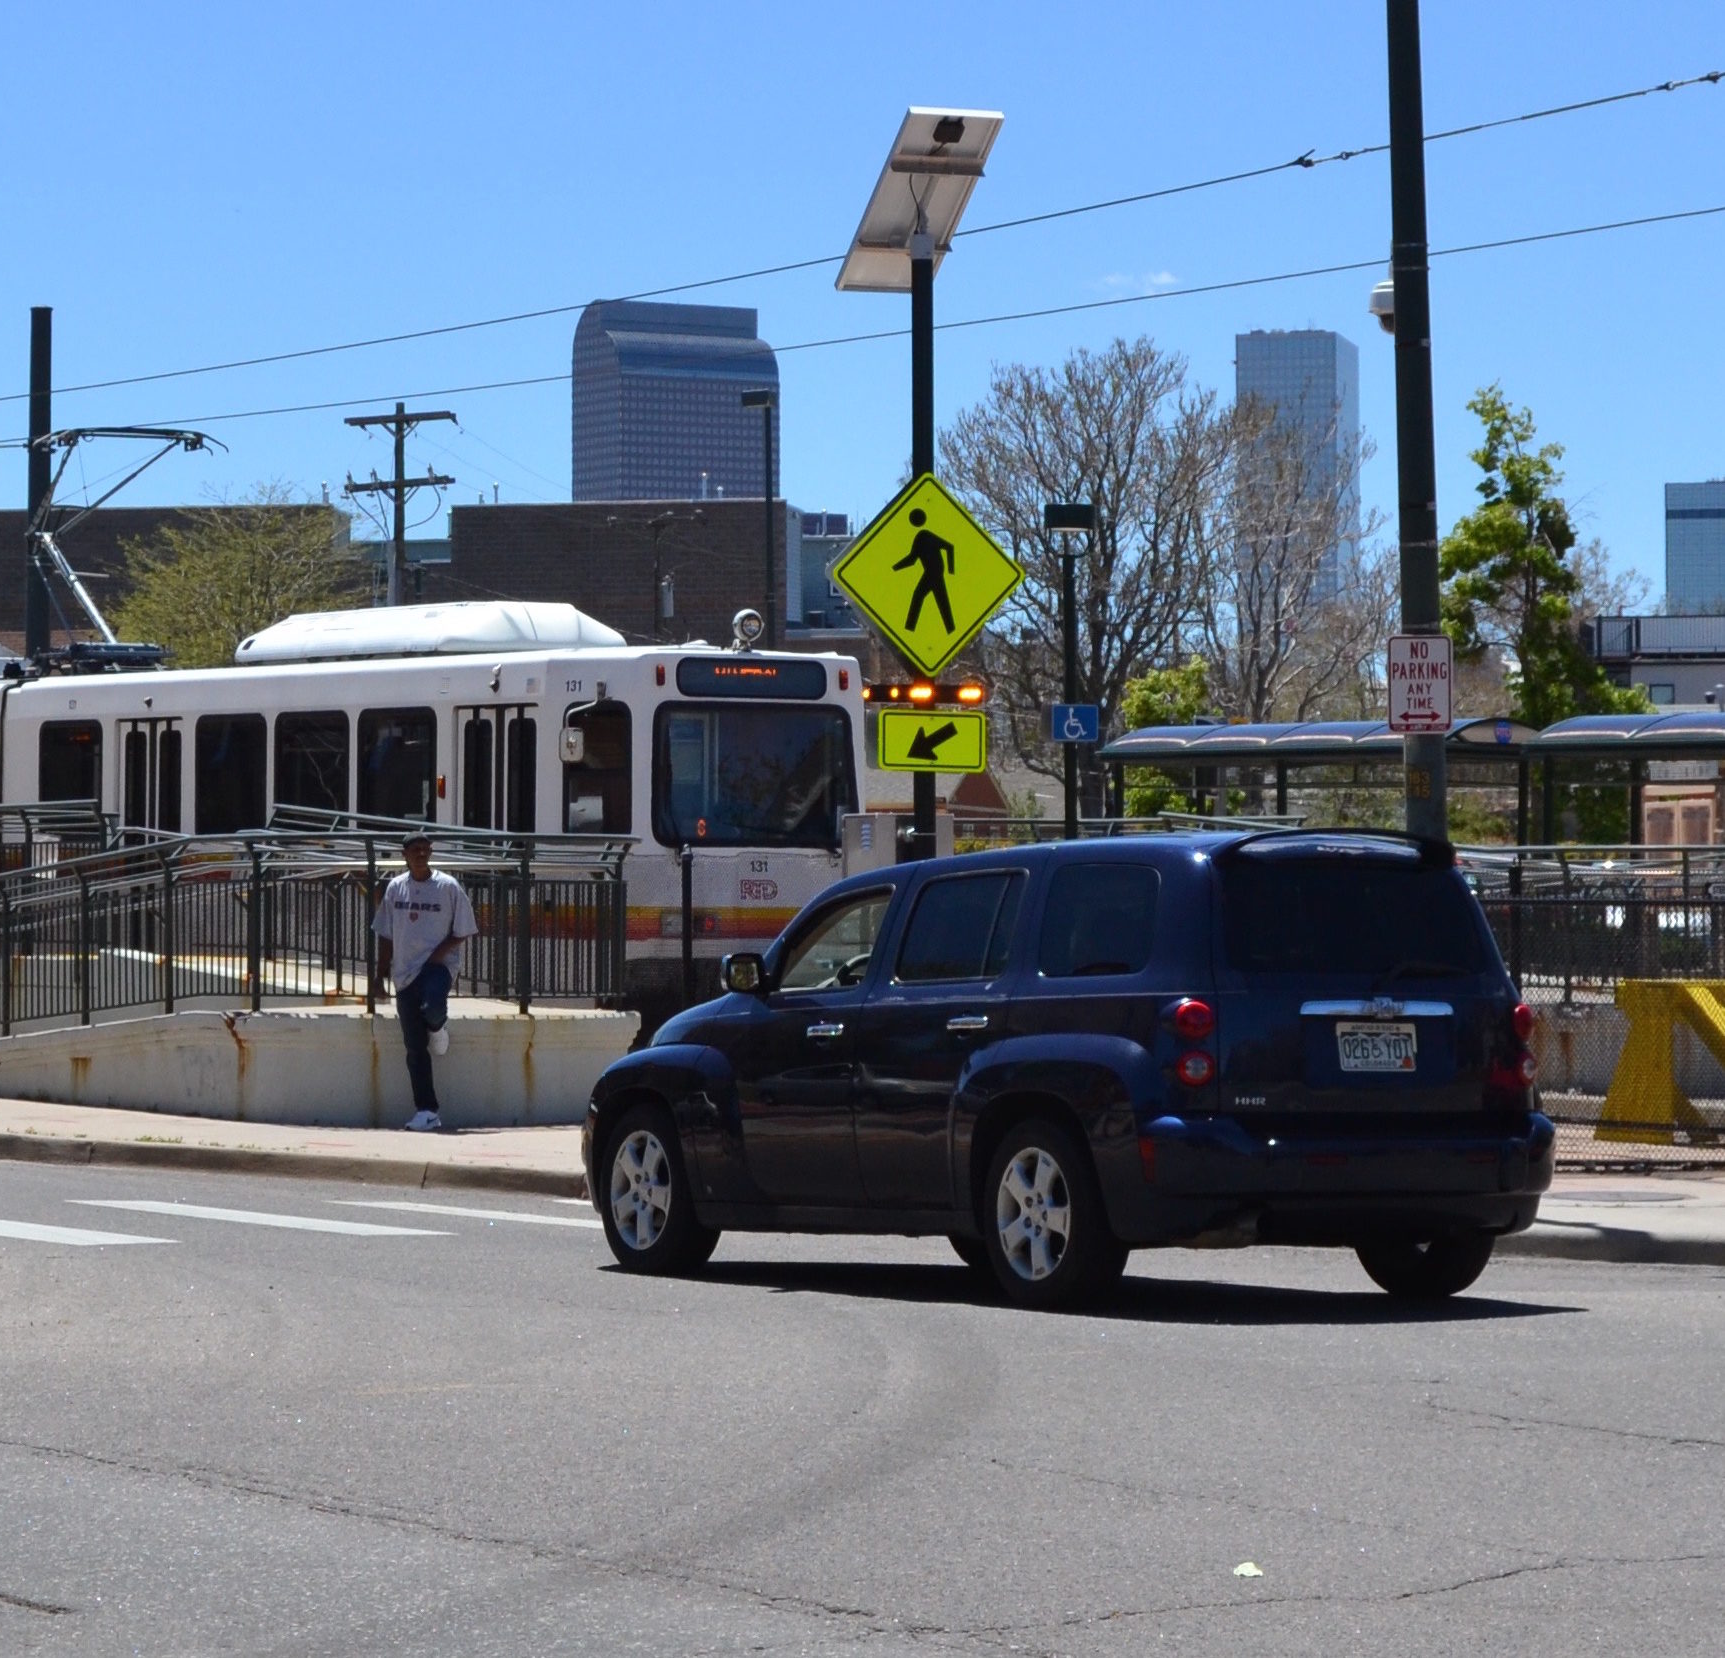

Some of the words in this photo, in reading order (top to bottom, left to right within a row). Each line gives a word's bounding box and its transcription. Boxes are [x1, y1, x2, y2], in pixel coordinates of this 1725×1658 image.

[1410, 641, 1429, 659] NO
[1392, 662, 1448, 680] PARKING
[565, 680, 582, 692] 131
[1407, 683, 1432, 695] ANY
[1406, 697, 1434, 710] TIME
[750, 860, 769, 873] 131
[740, 879, 778, 900] RTD
[1343, 1038, 1370, 1059] 026
